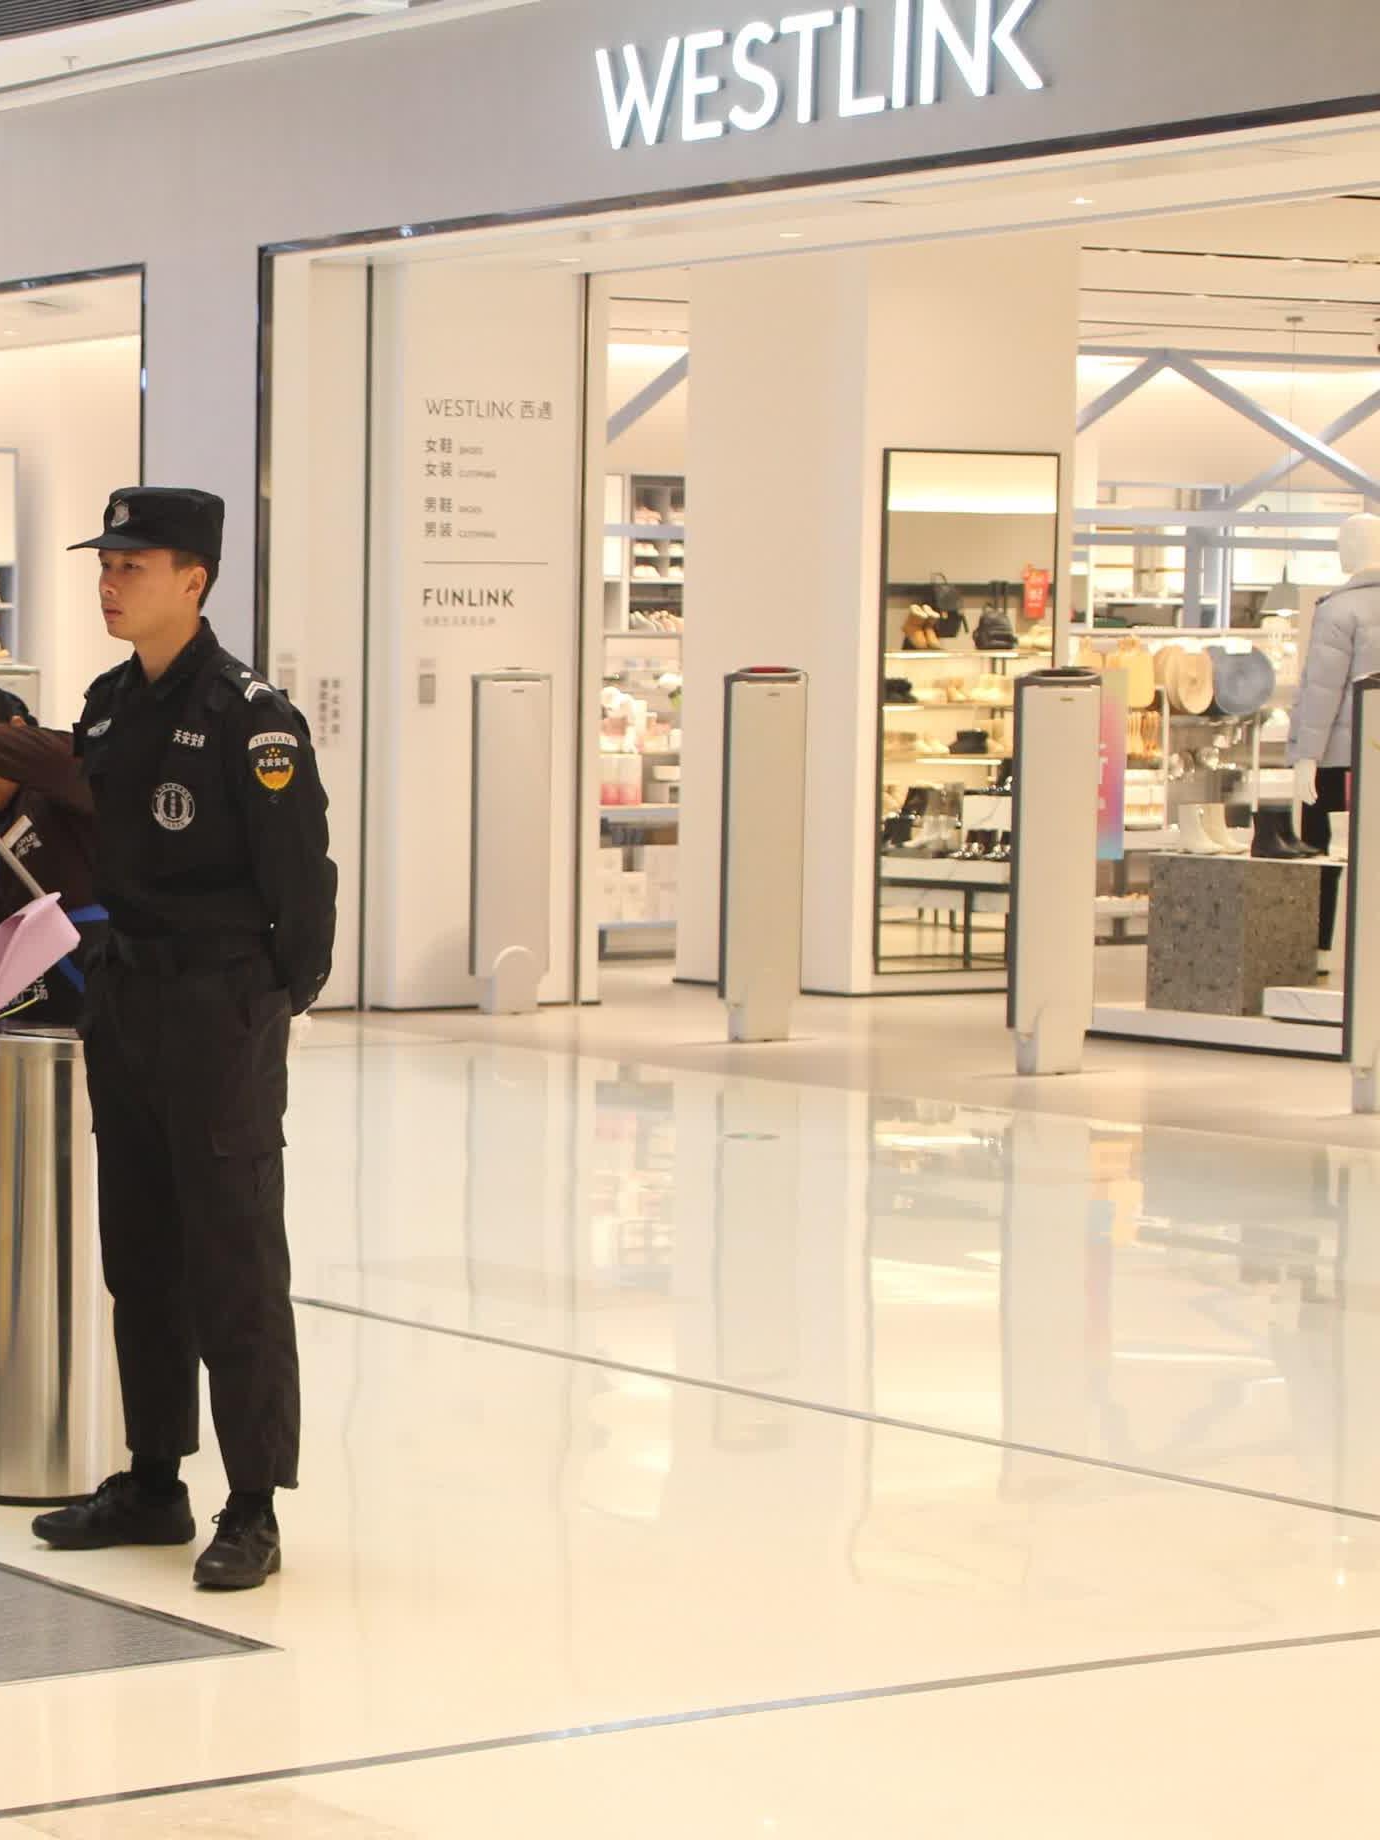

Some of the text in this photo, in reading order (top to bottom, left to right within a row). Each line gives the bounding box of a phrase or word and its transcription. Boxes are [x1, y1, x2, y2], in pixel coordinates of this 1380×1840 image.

[595, 0, 1044, 150] WESTLINK
[425, 398, 515, 418] WESTLINK
[422, 587, 515, 607] FUNLINK
